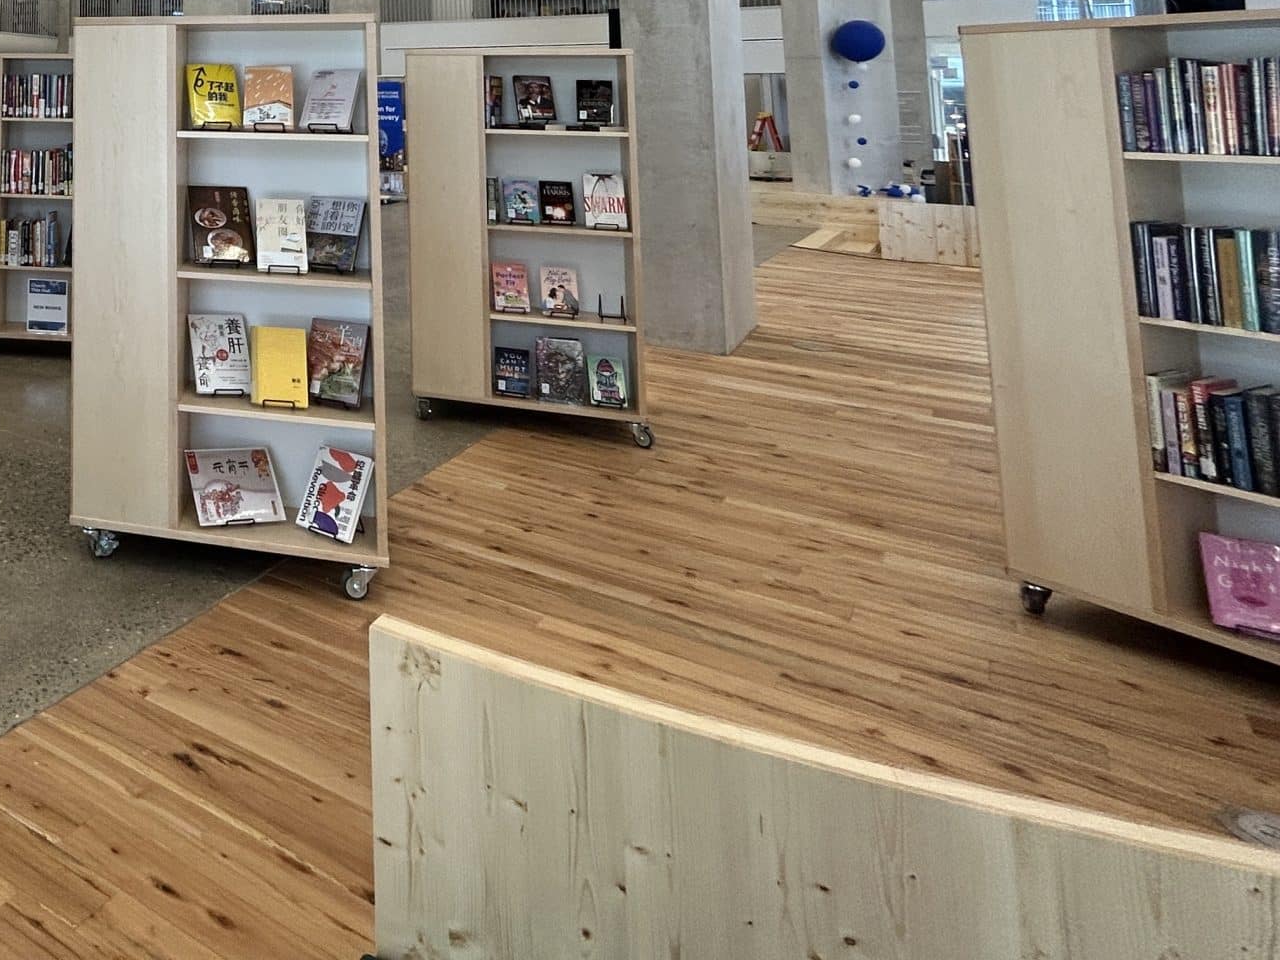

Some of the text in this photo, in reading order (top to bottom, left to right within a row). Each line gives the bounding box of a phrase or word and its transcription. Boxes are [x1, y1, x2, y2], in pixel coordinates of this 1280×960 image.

[207, 80, 234, 92] 了不起
[583, 196, 625, 214] SWARM
[224, 318, 245, 354] 養肝
[503, 352, 523, 360] YOU
[299, 467, 323, 522] Revolution
